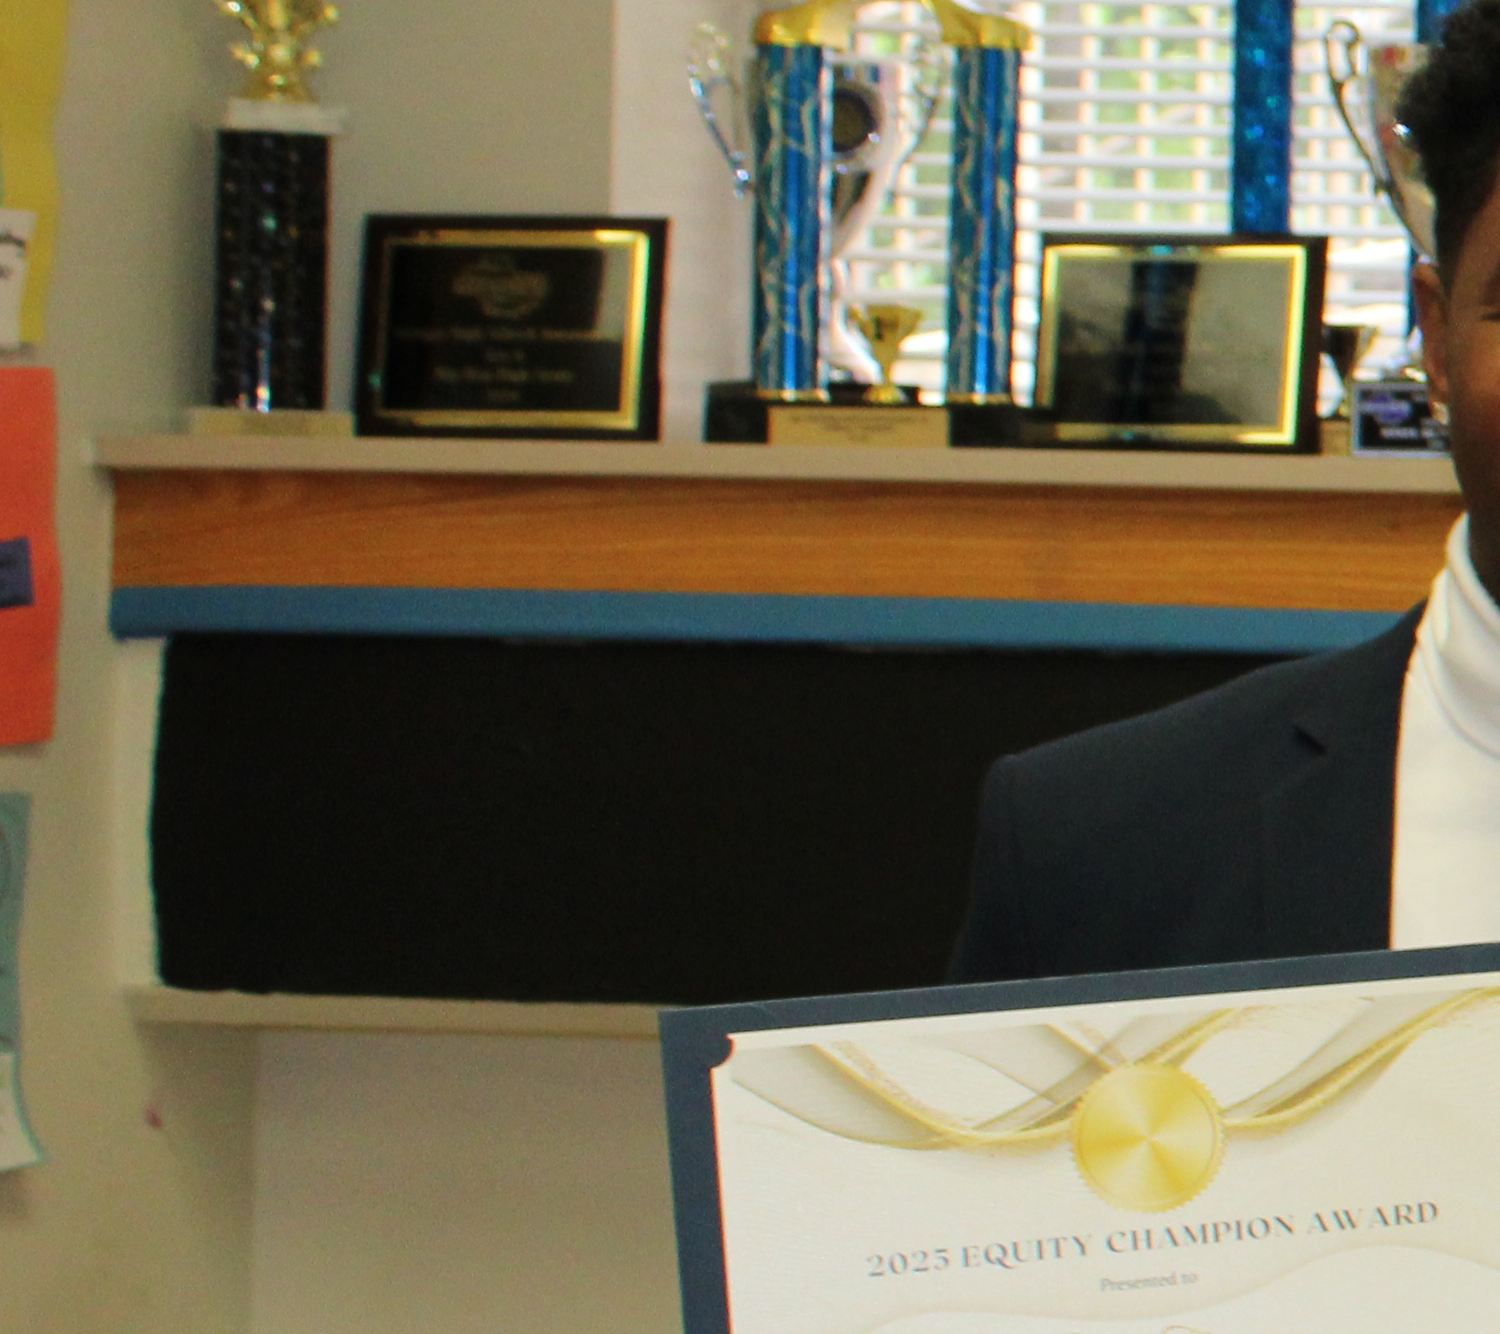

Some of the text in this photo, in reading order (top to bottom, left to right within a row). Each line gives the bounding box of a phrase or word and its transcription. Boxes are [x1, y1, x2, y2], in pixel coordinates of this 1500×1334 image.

[866, 1201, 1439, 1277] 2025 EQUITY CHAMPION AWARD
[1100, 1272, 1199, 1293] Presented to
